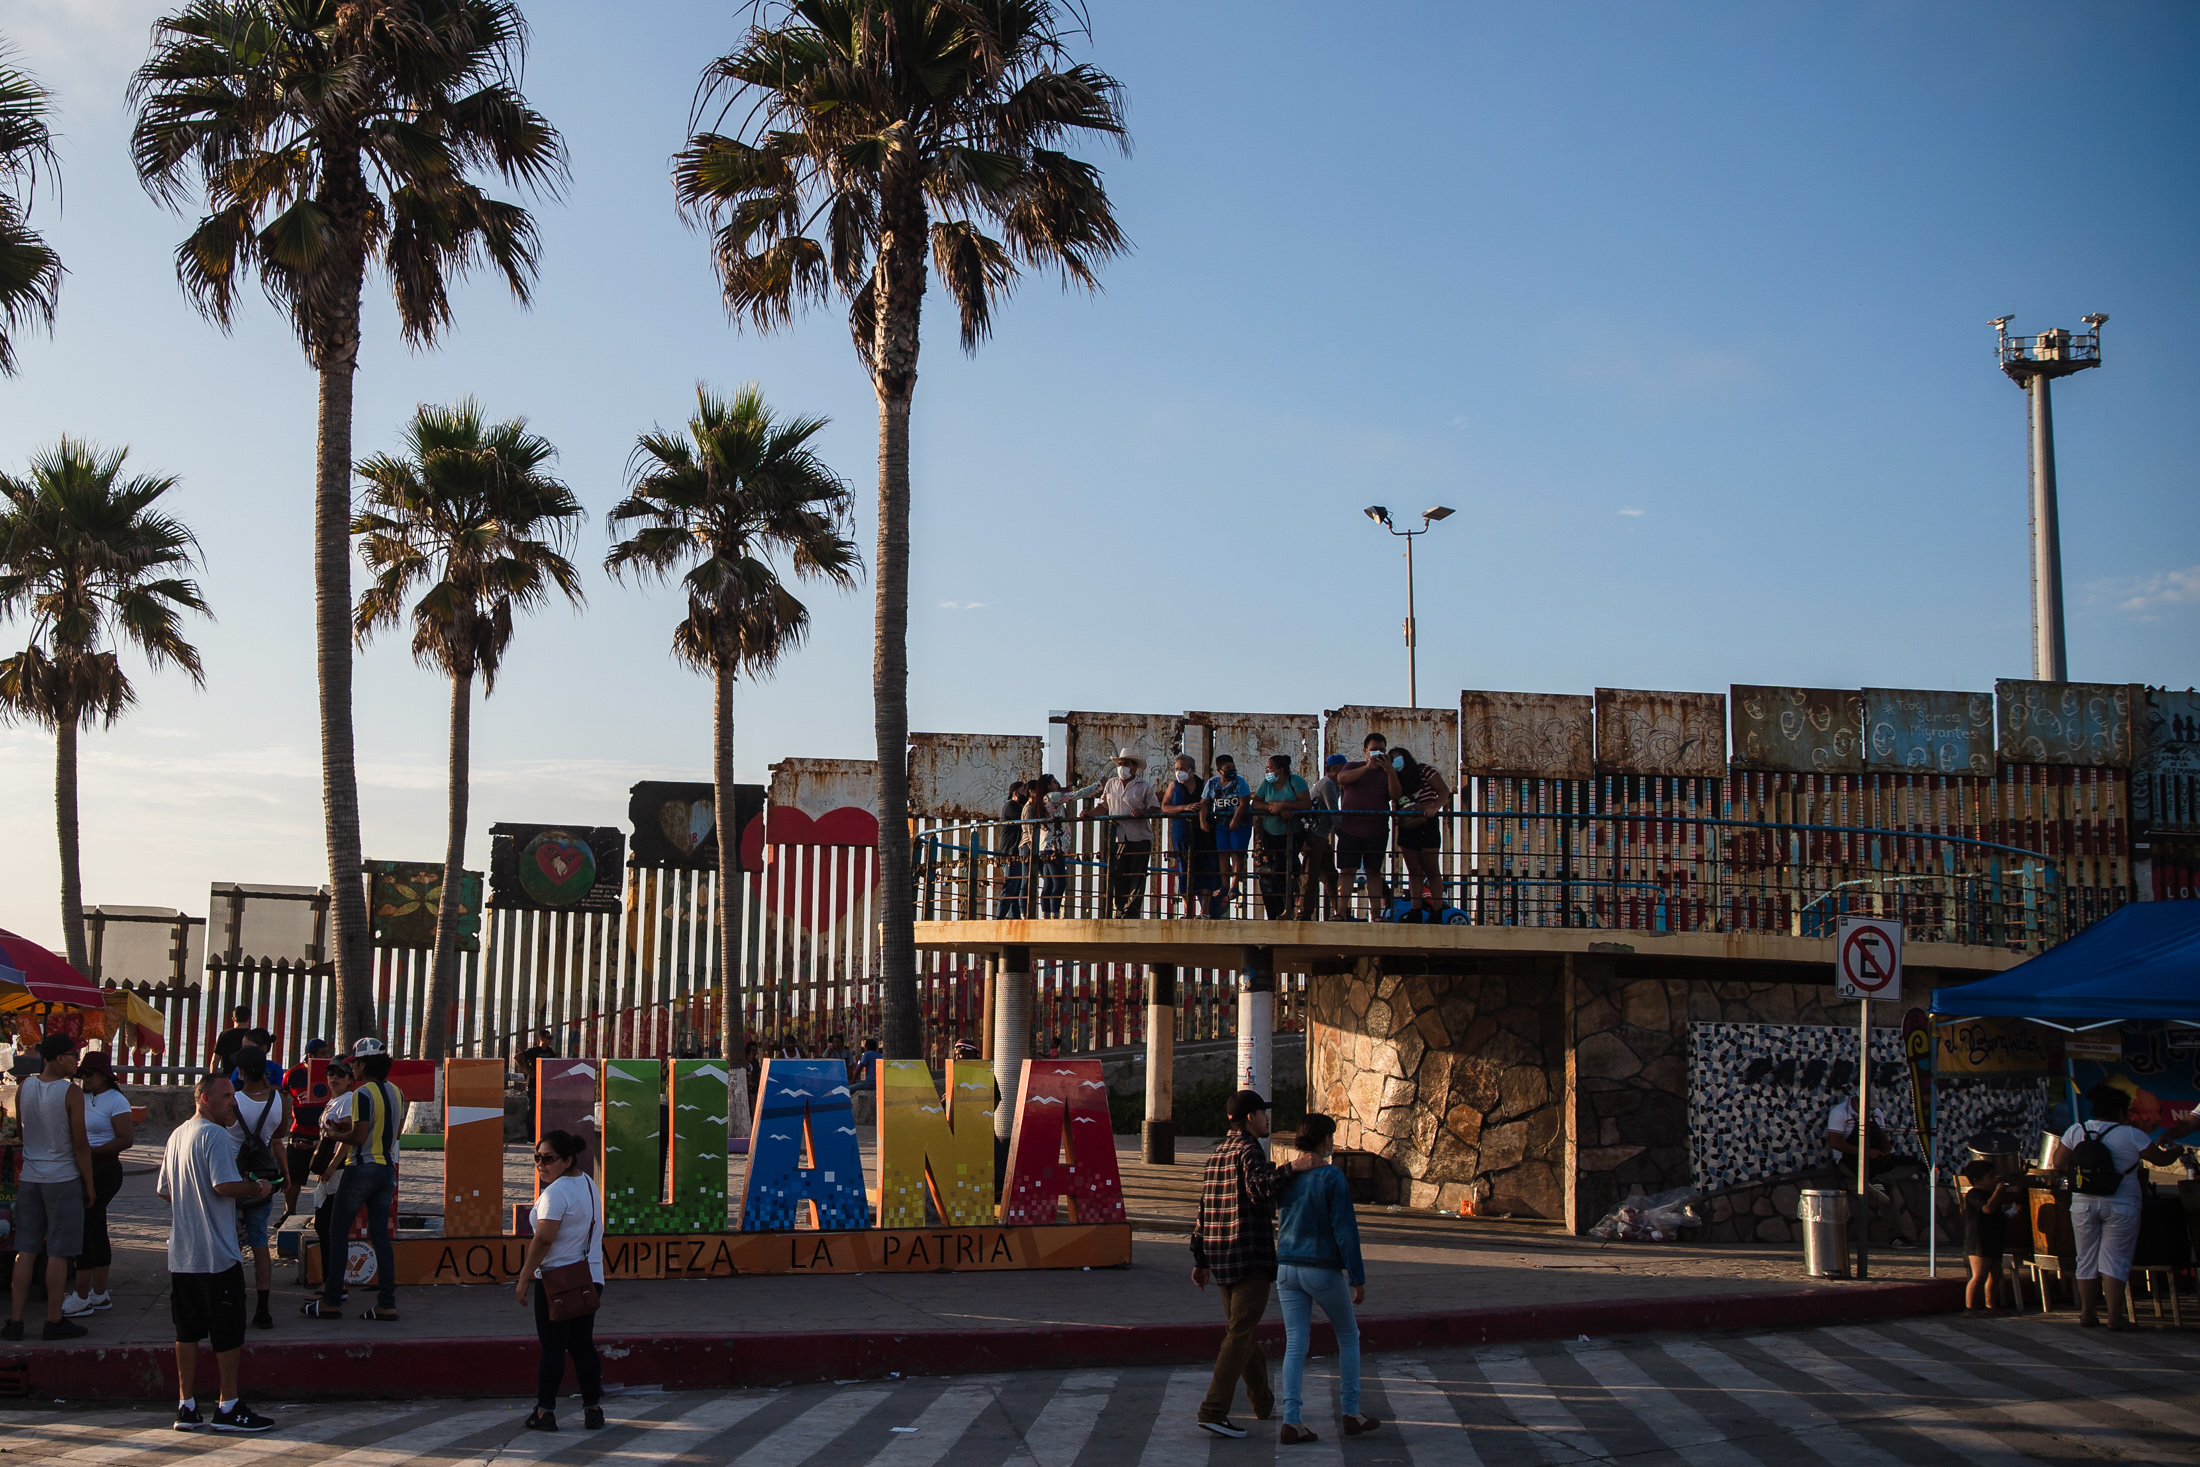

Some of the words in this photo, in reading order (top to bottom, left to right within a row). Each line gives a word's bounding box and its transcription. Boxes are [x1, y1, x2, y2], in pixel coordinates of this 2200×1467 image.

[1916, 711, 1961, 723] Somos
[1910, 726, 1979, 741] Migrantes
[2162, 767, 2200, 776] HERMAND
[2180, 778, 2189, 815] LOVE
[677, 963, 722, 983] CORAZO
[1944, 1024, 1957, 1054] el
[2124, 1034, 2165, 1074] el
[434, 1244, 526, 1281] AQU
[602, 1239, 737, 1274] MPIEZA
[791, 1238, 834, 1269] LA
[883, 1233, 1013, 1266] PATRIA
